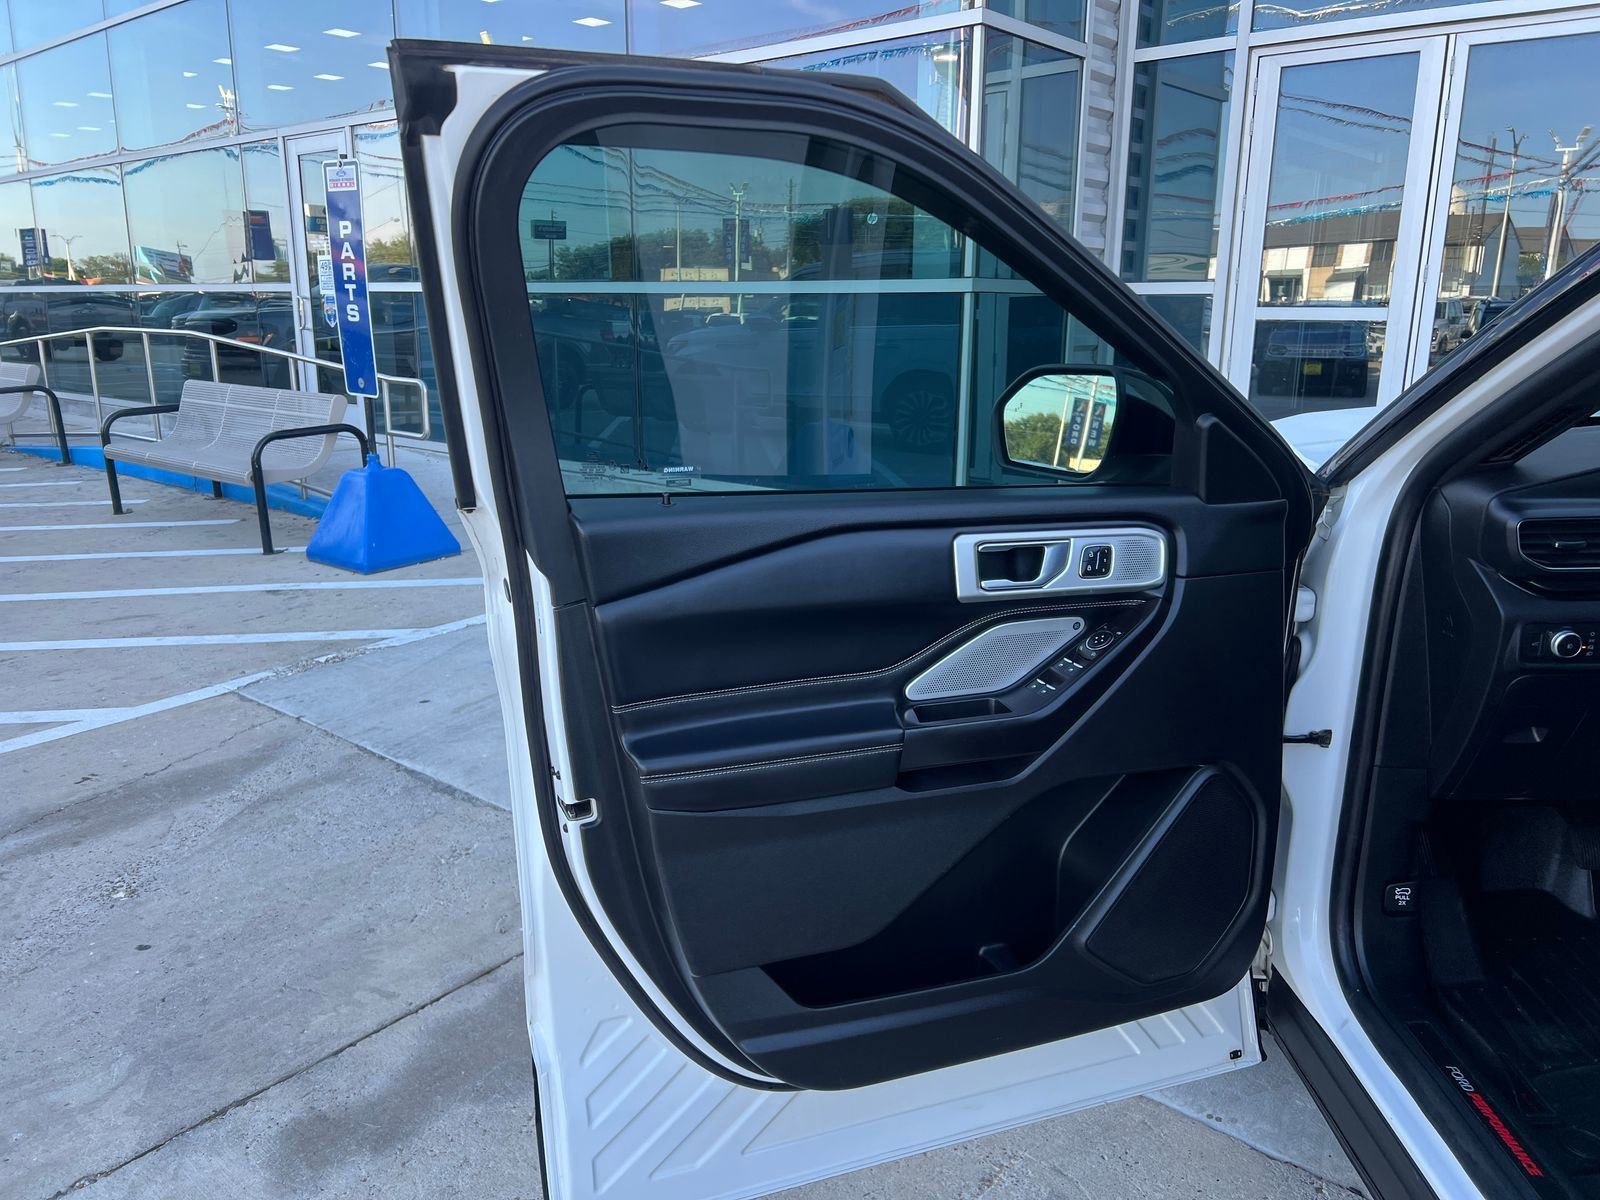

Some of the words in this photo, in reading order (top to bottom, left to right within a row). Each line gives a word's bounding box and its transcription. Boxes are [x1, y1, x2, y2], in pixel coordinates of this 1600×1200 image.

[339, 220, 360, 322] PARTS
[1445, 1065, 1475, 1092] FORD
[1466, 1091, 1545, 1178] PERFORMANCE
